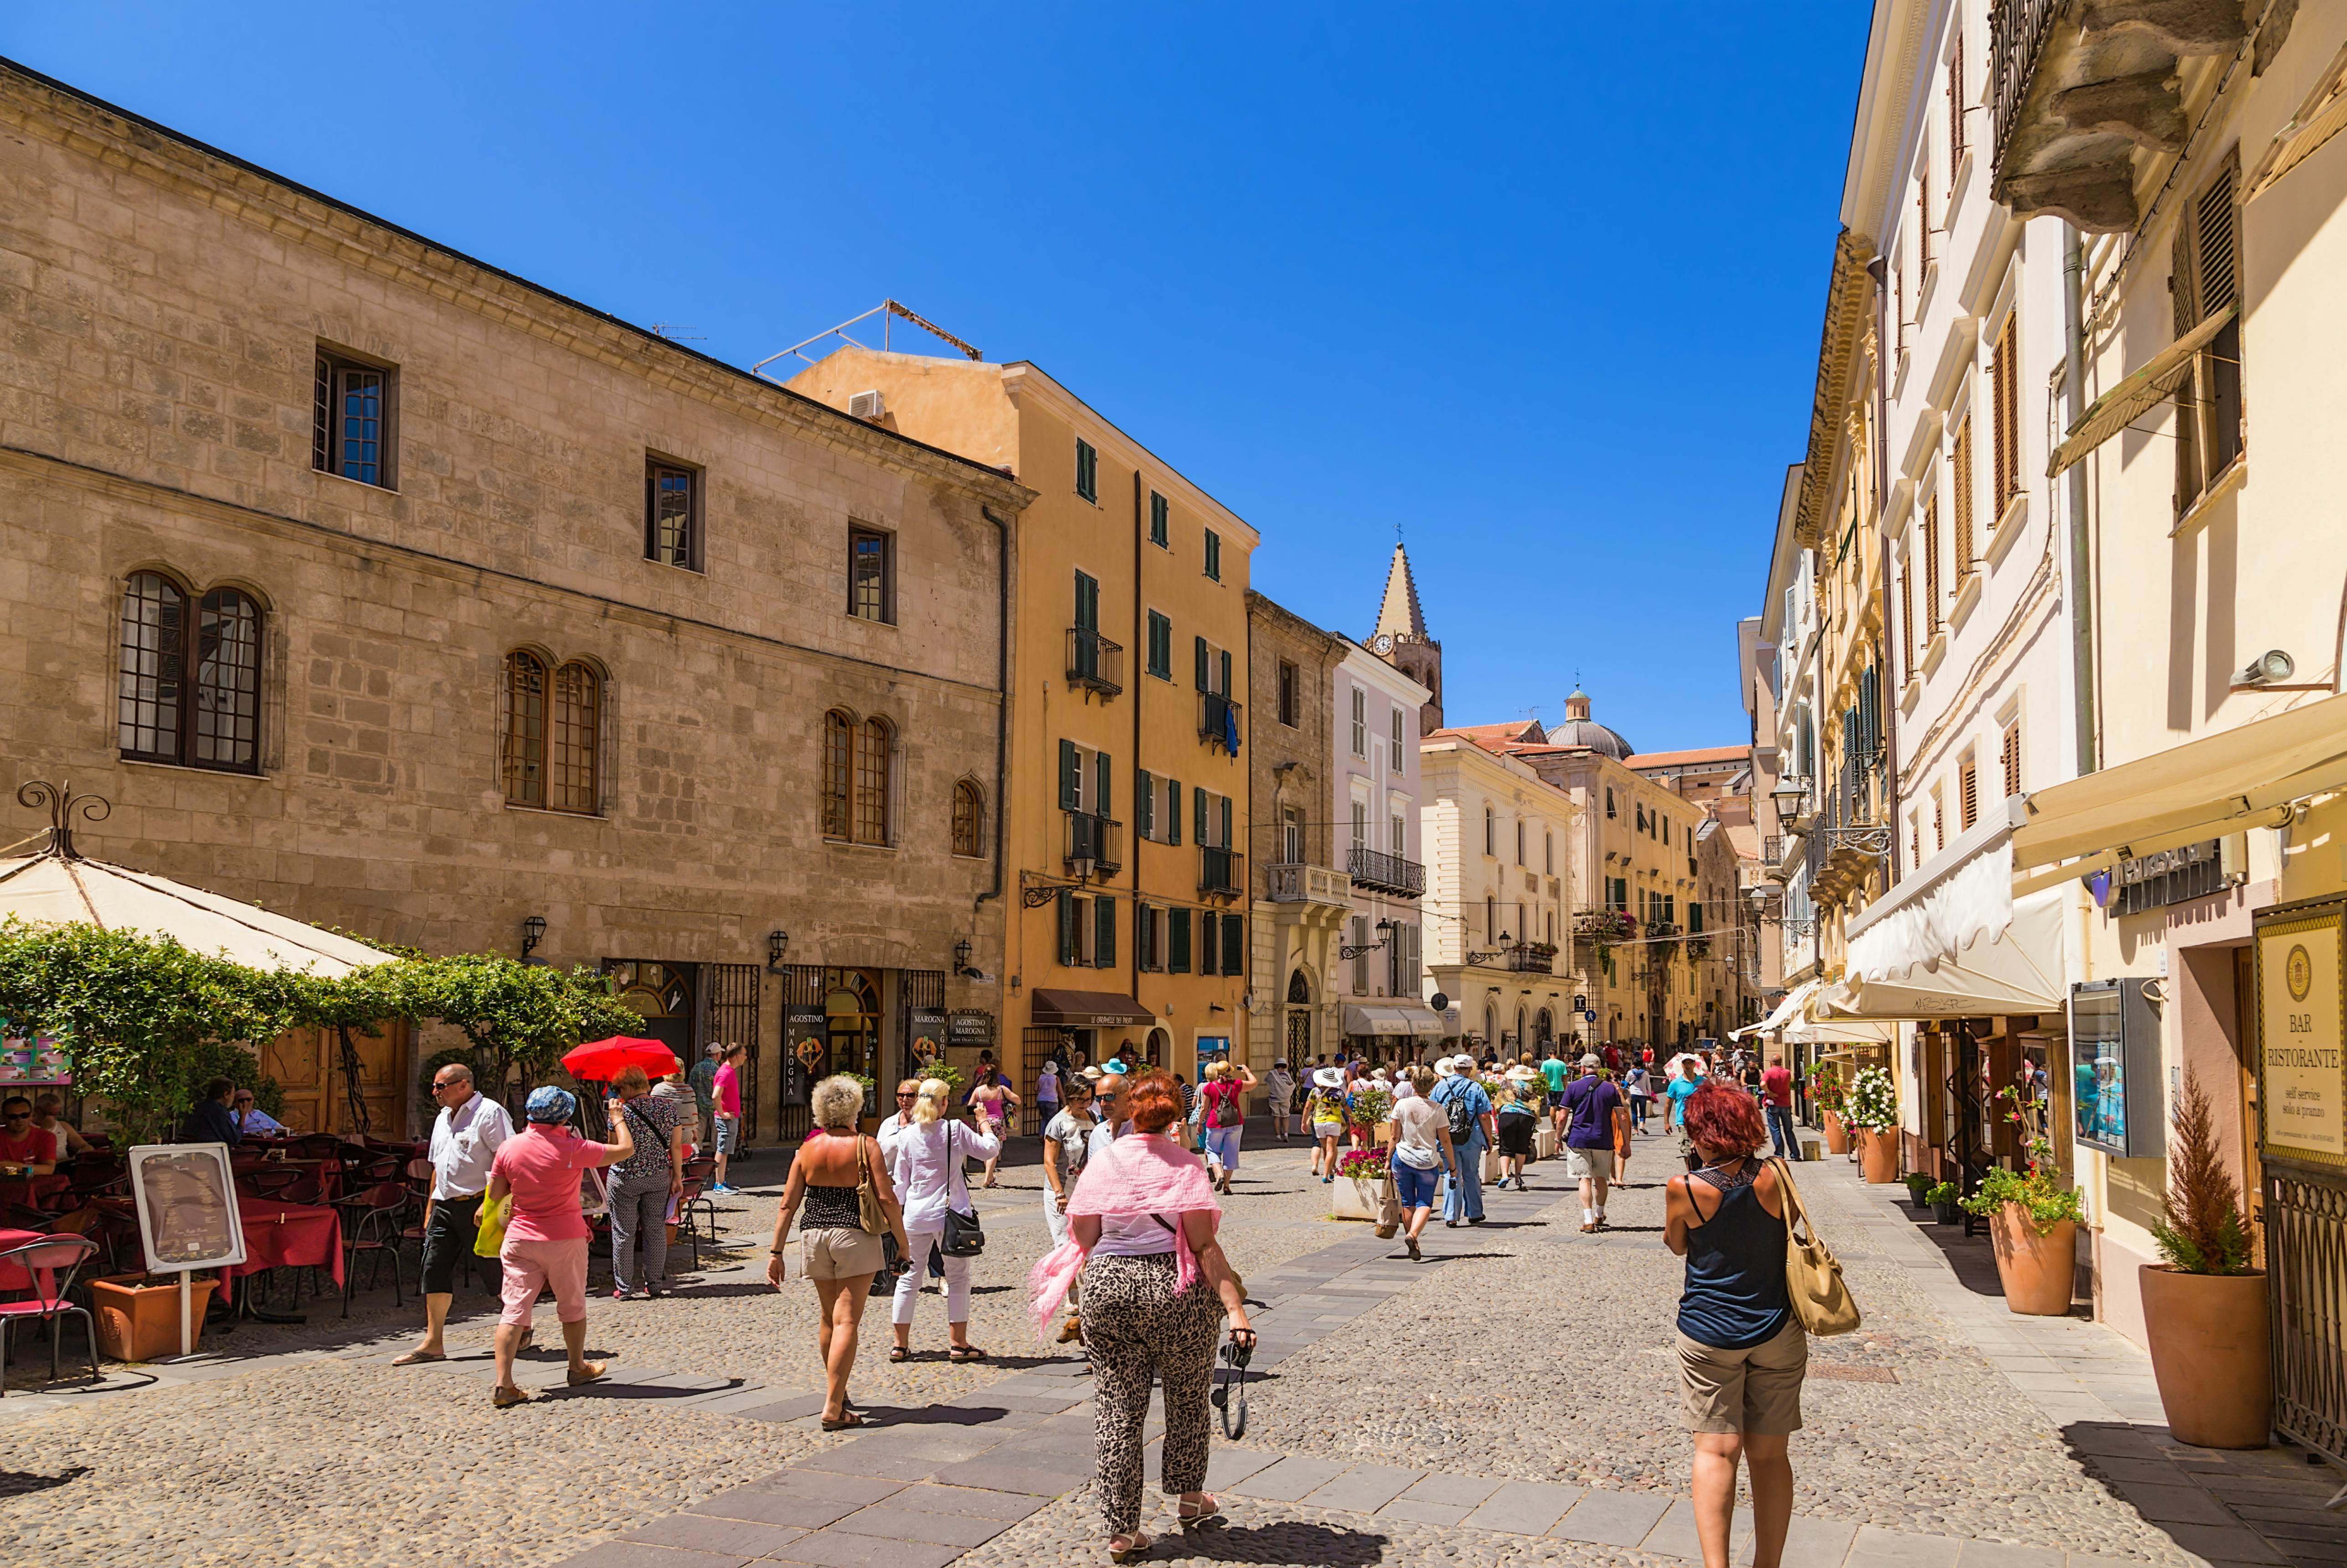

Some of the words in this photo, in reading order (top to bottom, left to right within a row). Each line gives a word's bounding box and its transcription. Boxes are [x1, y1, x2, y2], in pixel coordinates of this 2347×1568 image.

[1096, 1016, 1115, 1024] CARAMELLE
[2290, 1014, 2311, 1032] BAR
[2267, 1049, 2339, 1068] RISTORANTE
[2285, 1086, 2297, 1099] self
[2298, 1088, 2321, 1101] service
[2283, 1102, 2295, 1114] solo
[2296, 1106, 2300, 1115] a
[2301, 1107, 2325, 1119] pranzo
